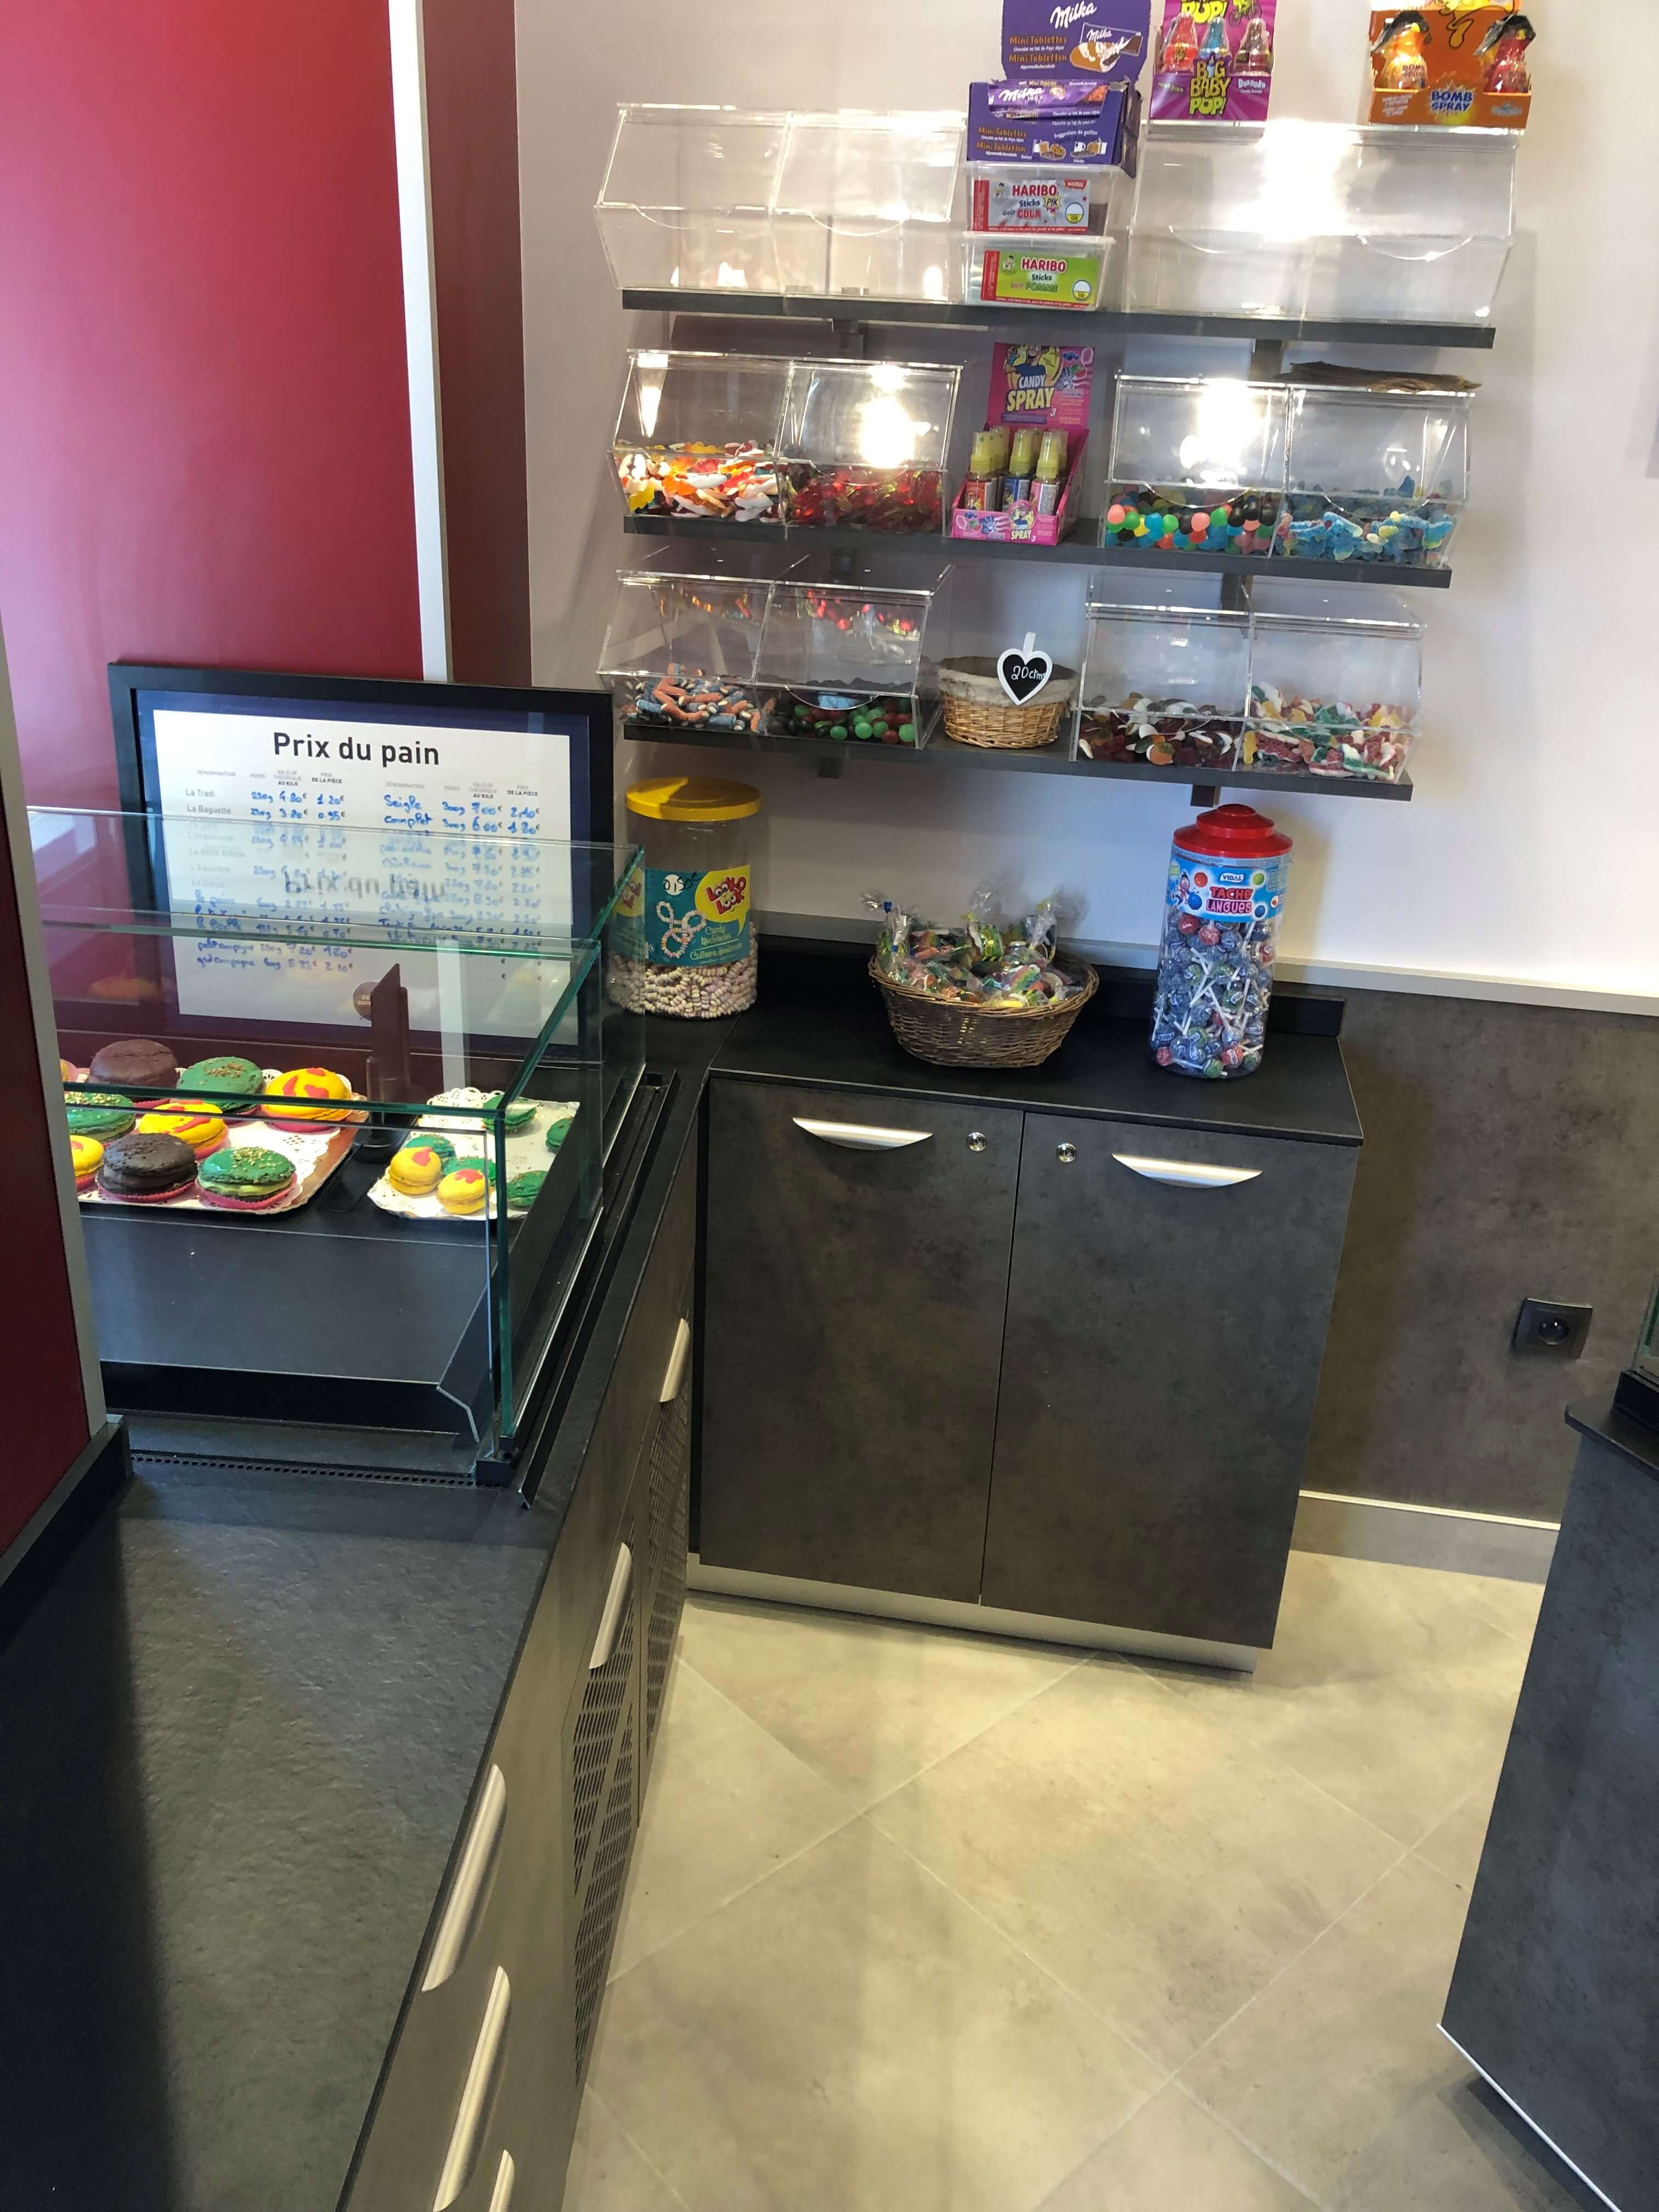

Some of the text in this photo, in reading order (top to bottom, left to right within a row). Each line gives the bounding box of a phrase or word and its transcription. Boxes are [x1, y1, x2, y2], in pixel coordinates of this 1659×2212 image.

[1049, 1, 1097, 29] Milka
[1086, 27, 1113, 41] Milka
[1009, 36, 1067, 44] Mini Tablettes
[1009, 54, 1028, 63] Mini
[1197, 59, 1226, 79] BIG
[1190, 77, 1231, 98] BABY
[998, 87, 1045, 102] Milka
[1431, 91, 1473, 101] BOMB
[1189, 97, 1227, 115] POP!
[1431, 102, 1470, 112] SPRAY
[978, 127, 1027, 138] Mini Tablettes
[977, 142, 992, 150] Mini
[1012, 184, 1058, 196] HARIBO
[1019, 199, 1040, 207] Sticks
[1046, 197, 1059, 206] PIK
[1018, 209, 1041, 218] COLA
[1022, 257, 1066, 273] HARIBO
[1031, 273, 1052, 281] Sticks
[1025, 281, 1058, 293] POMME
[1019, 375, 1046, 388] CANDY
[1007, 387, 1054, 411] SPRAY
[1011, 530, 1032, 540] SPRAY
[274, 732, 439, 768] Prix du pain
[185, 788, 215, 798] La Tradi
[384, 794, 422, 813] Seigle
[187, 804, 232, 815] La Baguette
[1222, 874, 1243, 882] VIDAL
